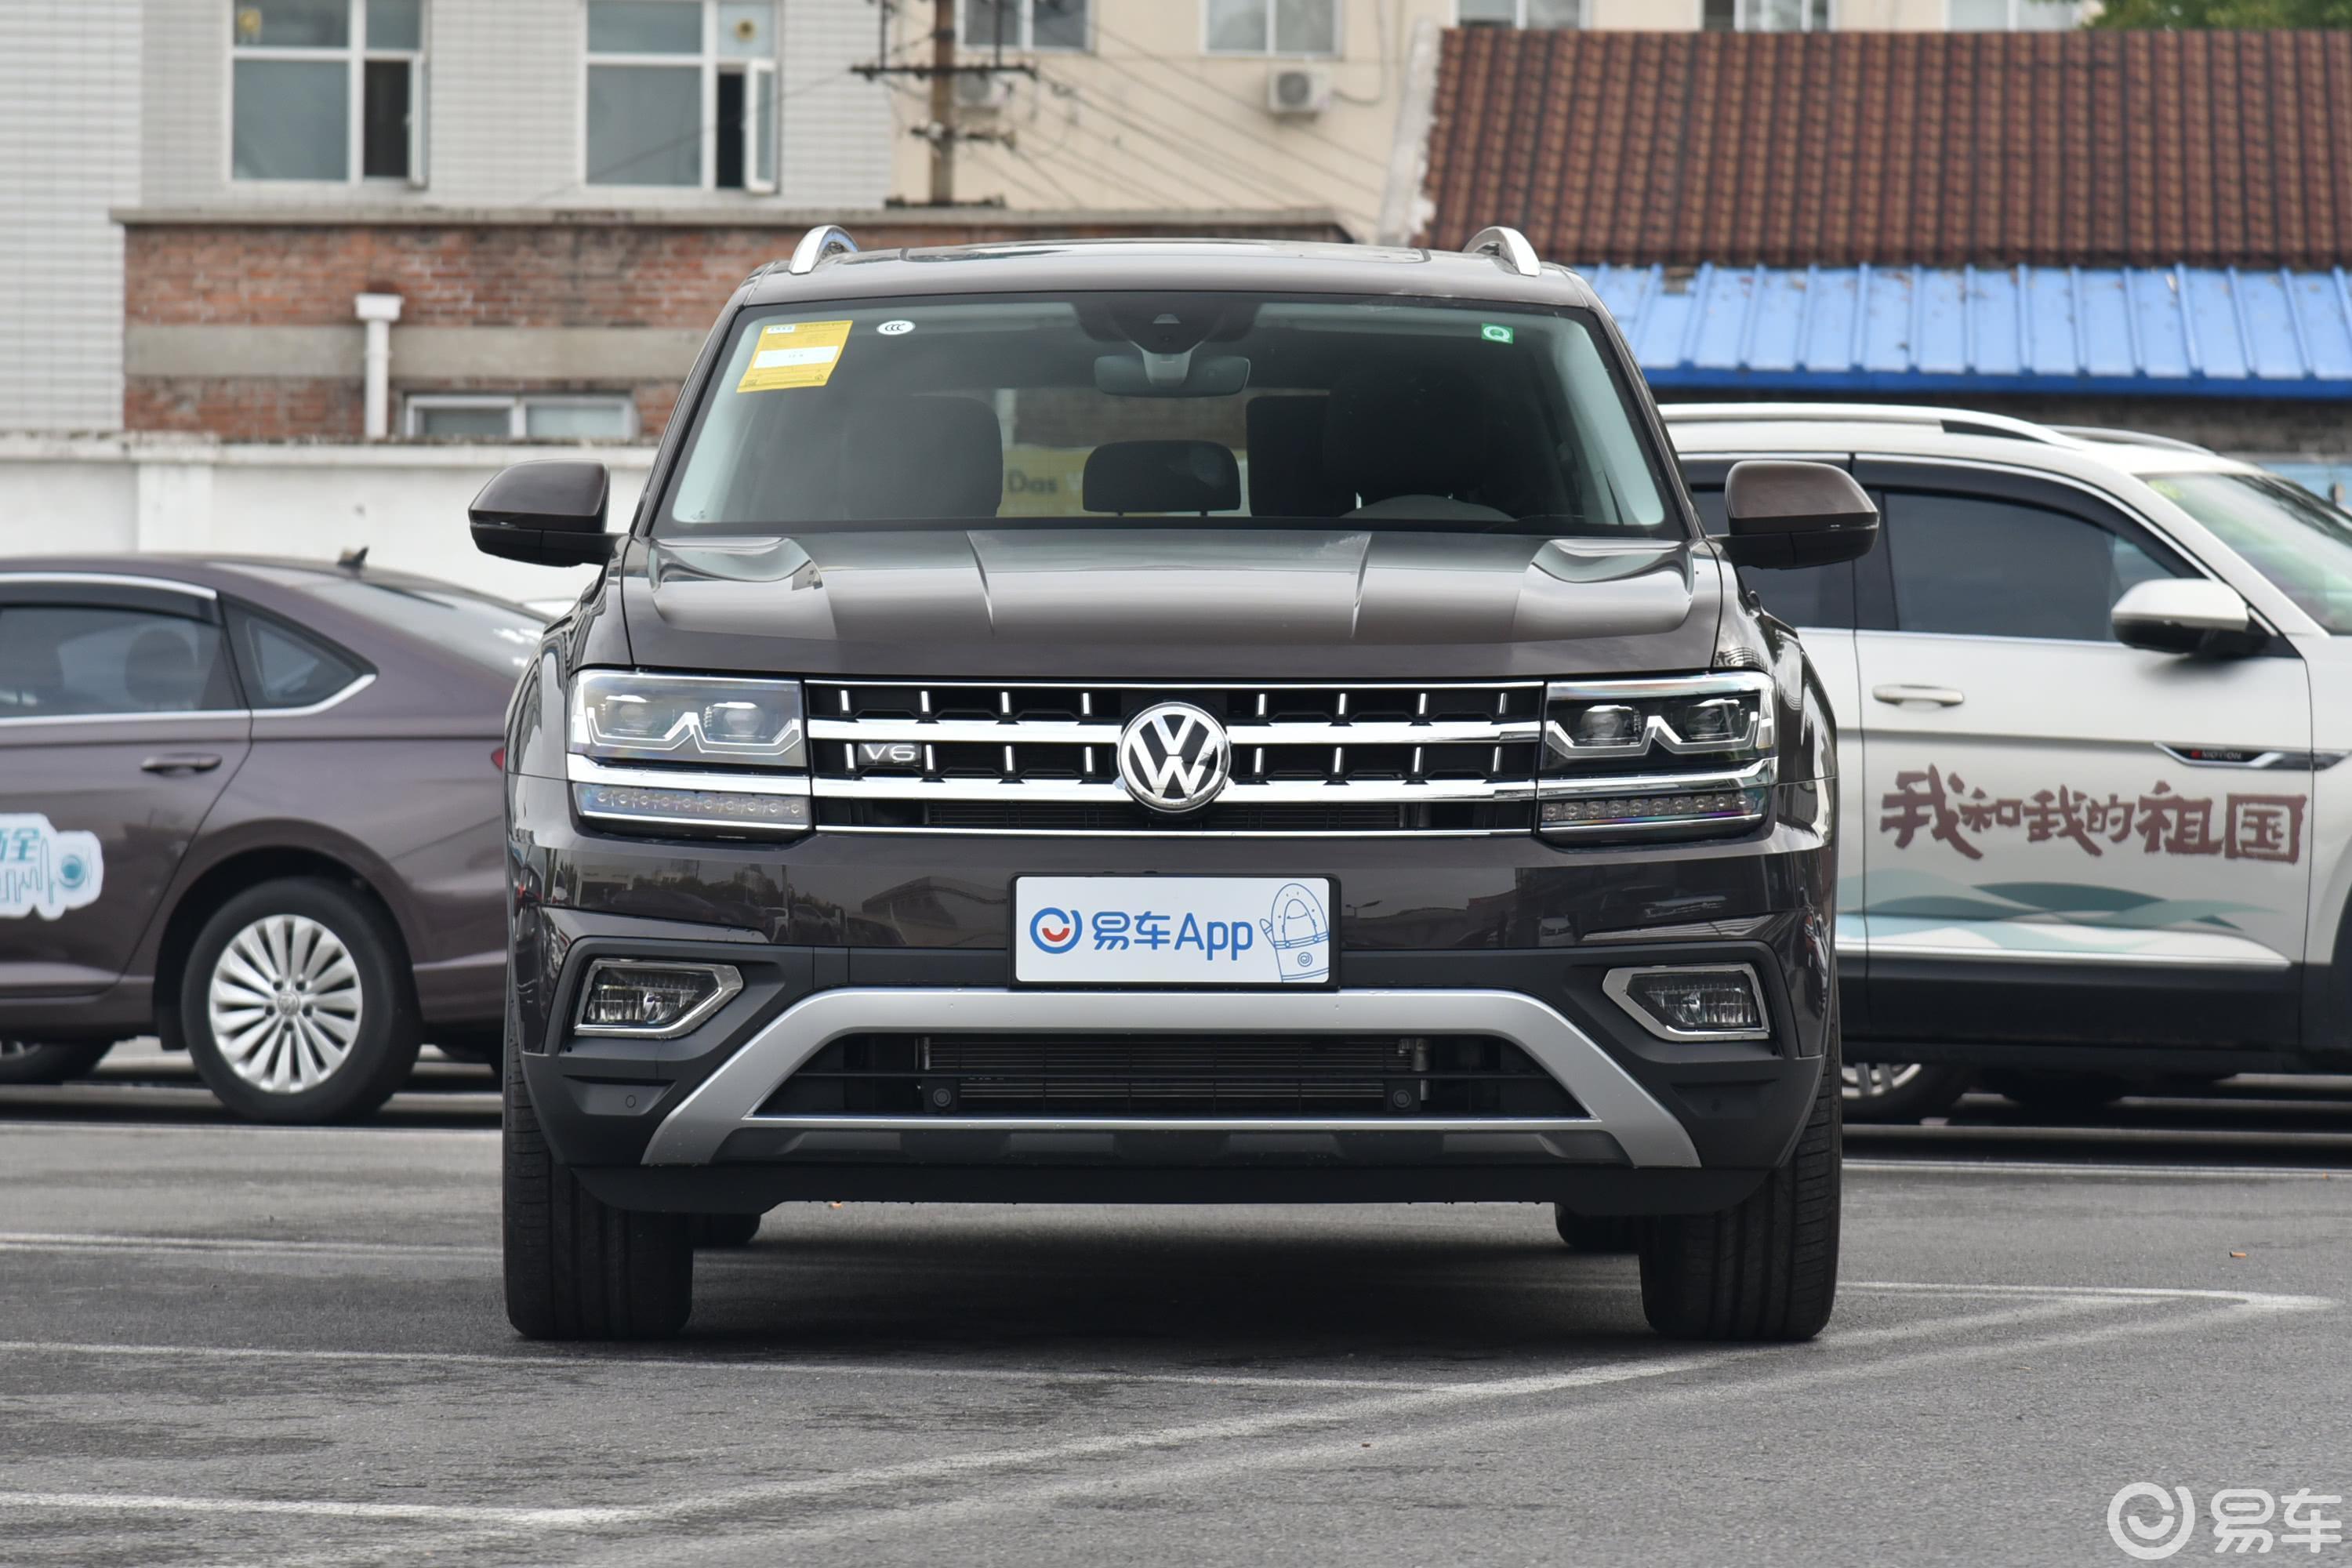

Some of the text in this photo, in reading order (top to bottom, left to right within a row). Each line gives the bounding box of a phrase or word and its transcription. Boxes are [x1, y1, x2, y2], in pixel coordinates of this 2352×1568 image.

[862, 744, 916, 762] V6
[1880, 763, 2307, 865] 我和我的祖国
